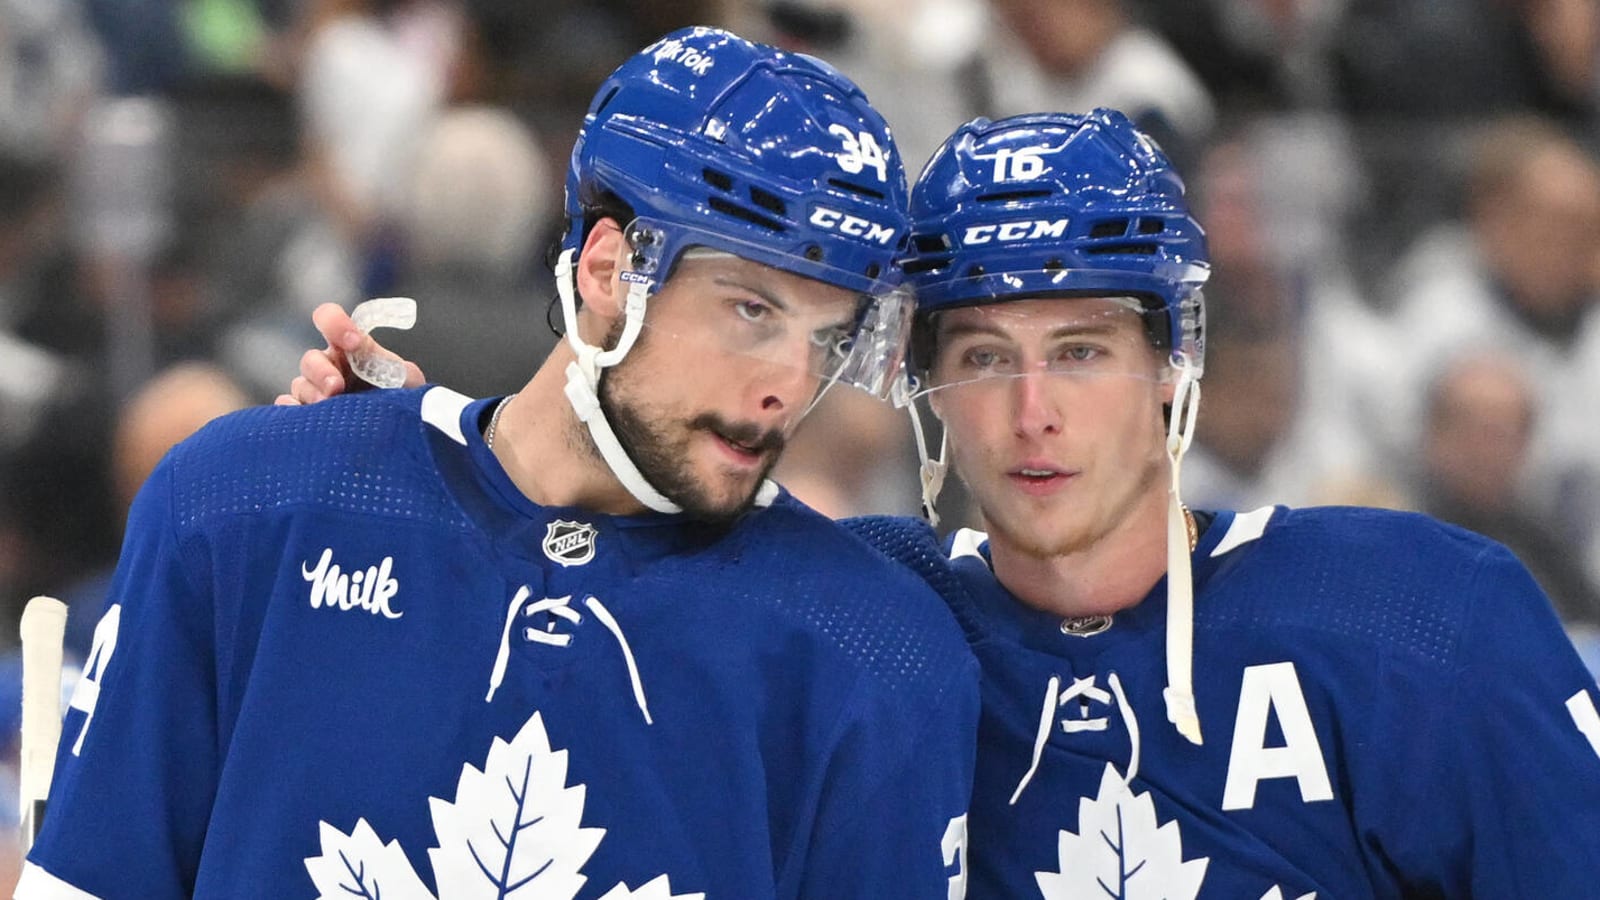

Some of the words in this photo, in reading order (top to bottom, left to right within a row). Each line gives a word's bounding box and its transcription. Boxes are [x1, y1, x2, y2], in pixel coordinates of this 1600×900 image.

[828, 123, 887, 182] 34
[993, 148, 1044, 183] 16
[810, 206, 895, 245] CCM
[963, 219, 1070, 245] CCM
[621, 272, 648, 283] CCM
[555, 533, 586, 553] NHL
[302, 547, 404, 619] Milk
[1221, 661, 1335, 811] A
